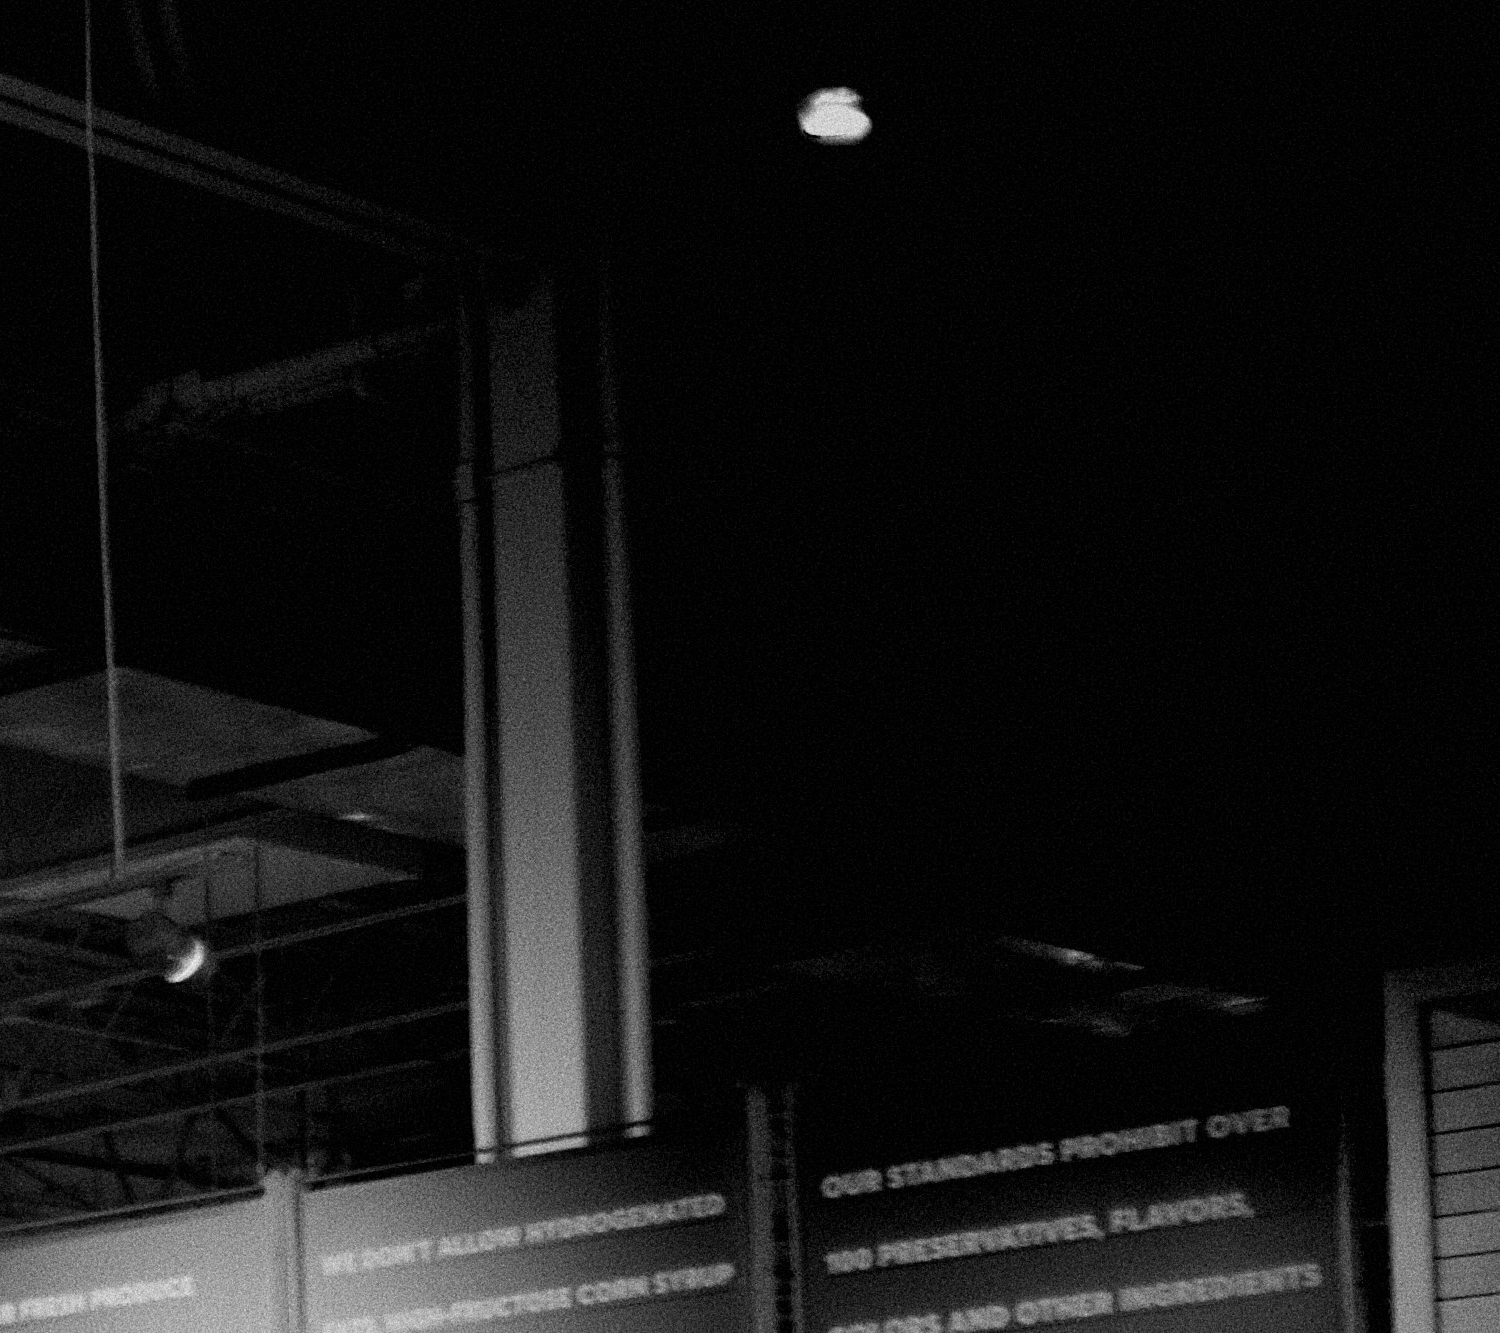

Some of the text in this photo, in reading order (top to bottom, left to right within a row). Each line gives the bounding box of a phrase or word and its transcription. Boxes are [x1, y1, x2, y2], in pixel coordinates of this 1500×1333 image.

[821, 1105, 1290, 1199] OUR STANDARDS PROHIBIT OVER
[321, 1251, 355, 1276] WE
[438, 1225, 520, 1256] ALLOW
[524, 1193, 725, 1243] HYDROGENATED
[876, 1213, 1103, 1267] PRESERVATIVES,
[1108, 1192, 1254, 1233] FLAVORS,
[19, 1293, 86, 1320] FRESH
[90, 1275, 193, 1310] PRODUCE
[576, 1276, 649, 1305] CORN
[653, 1262, 735, 1295] SYRUP
[1014, 1290, 1114, 1326] OTHER
[1118, 1262, 1322, 1312] INGREDIENTS
